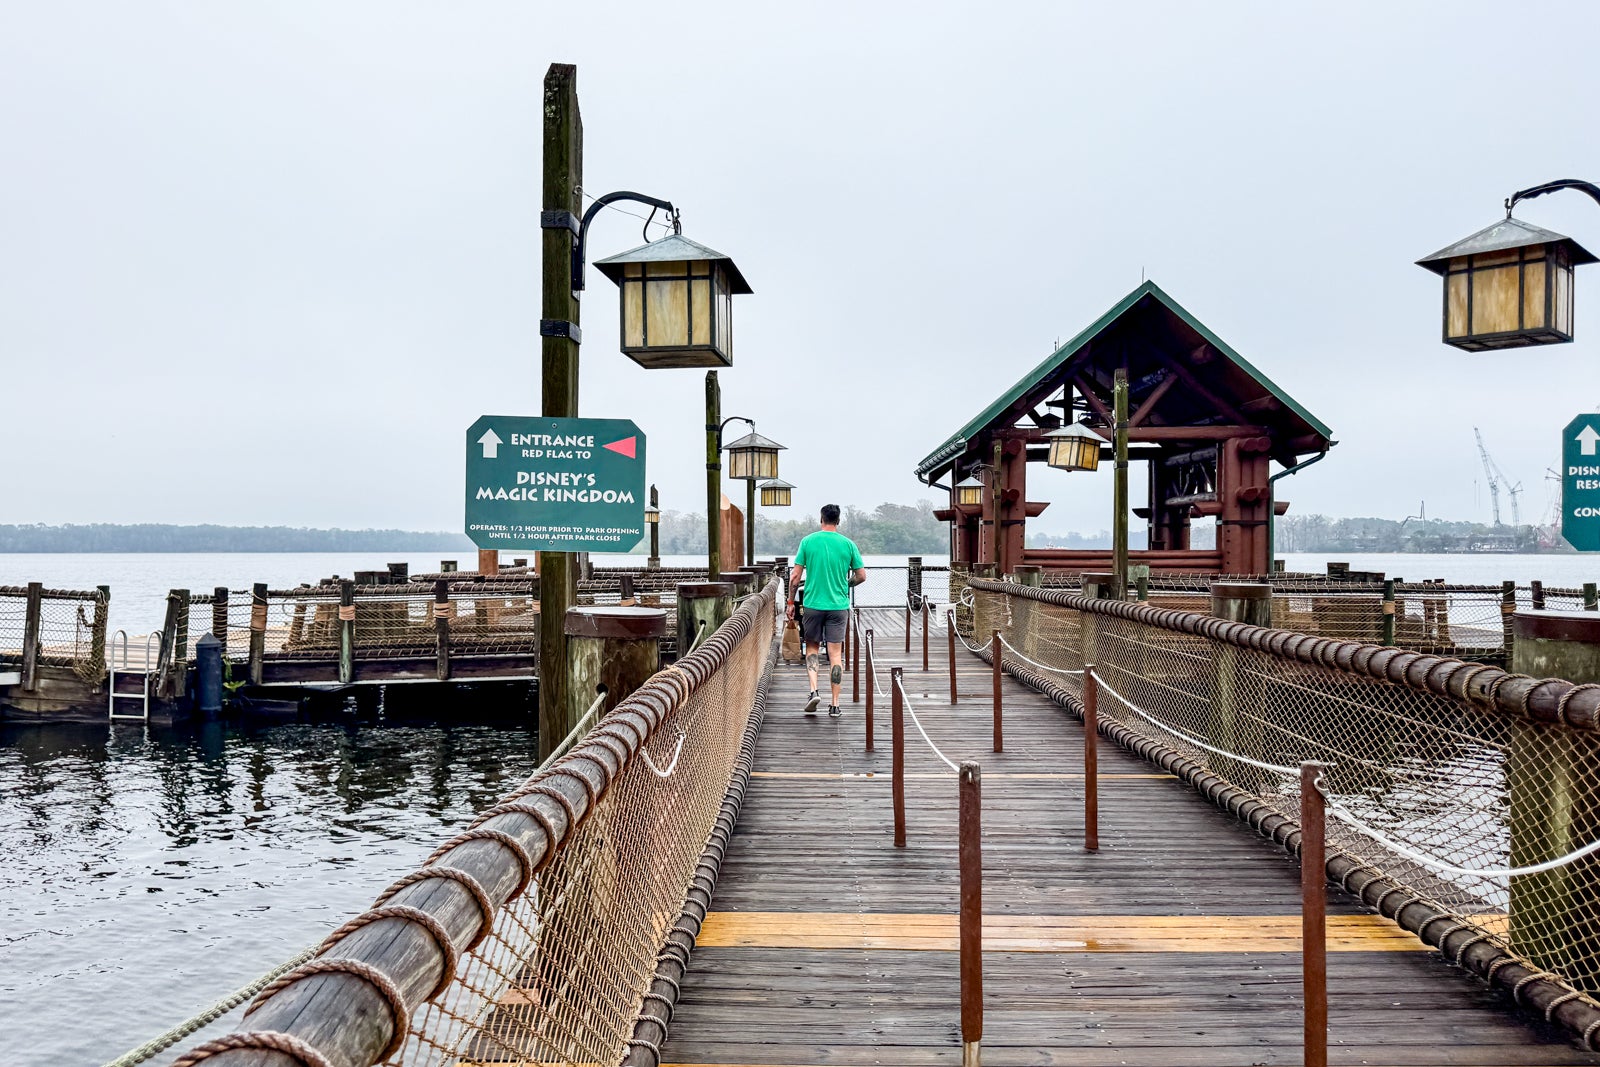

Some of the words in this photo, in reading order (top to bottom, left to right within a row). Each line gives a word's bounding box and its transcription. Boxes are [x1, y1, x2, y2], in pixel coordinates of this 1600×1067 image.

[511, 433, 595, 448] ENTRANCE
[521, 449, 543, 458] RED
[546, 450, 573, 459] FLAG
[575, 451, 592, 459] TO
[516, 471, 596, 486] DISNEY'S
[1576, 480, 1600, 490] RES
[475, 486, 538, 501] MAGIC
[543, 489, 635, 504] KINGDOM
[550, 533, 574, 541] AFTER
